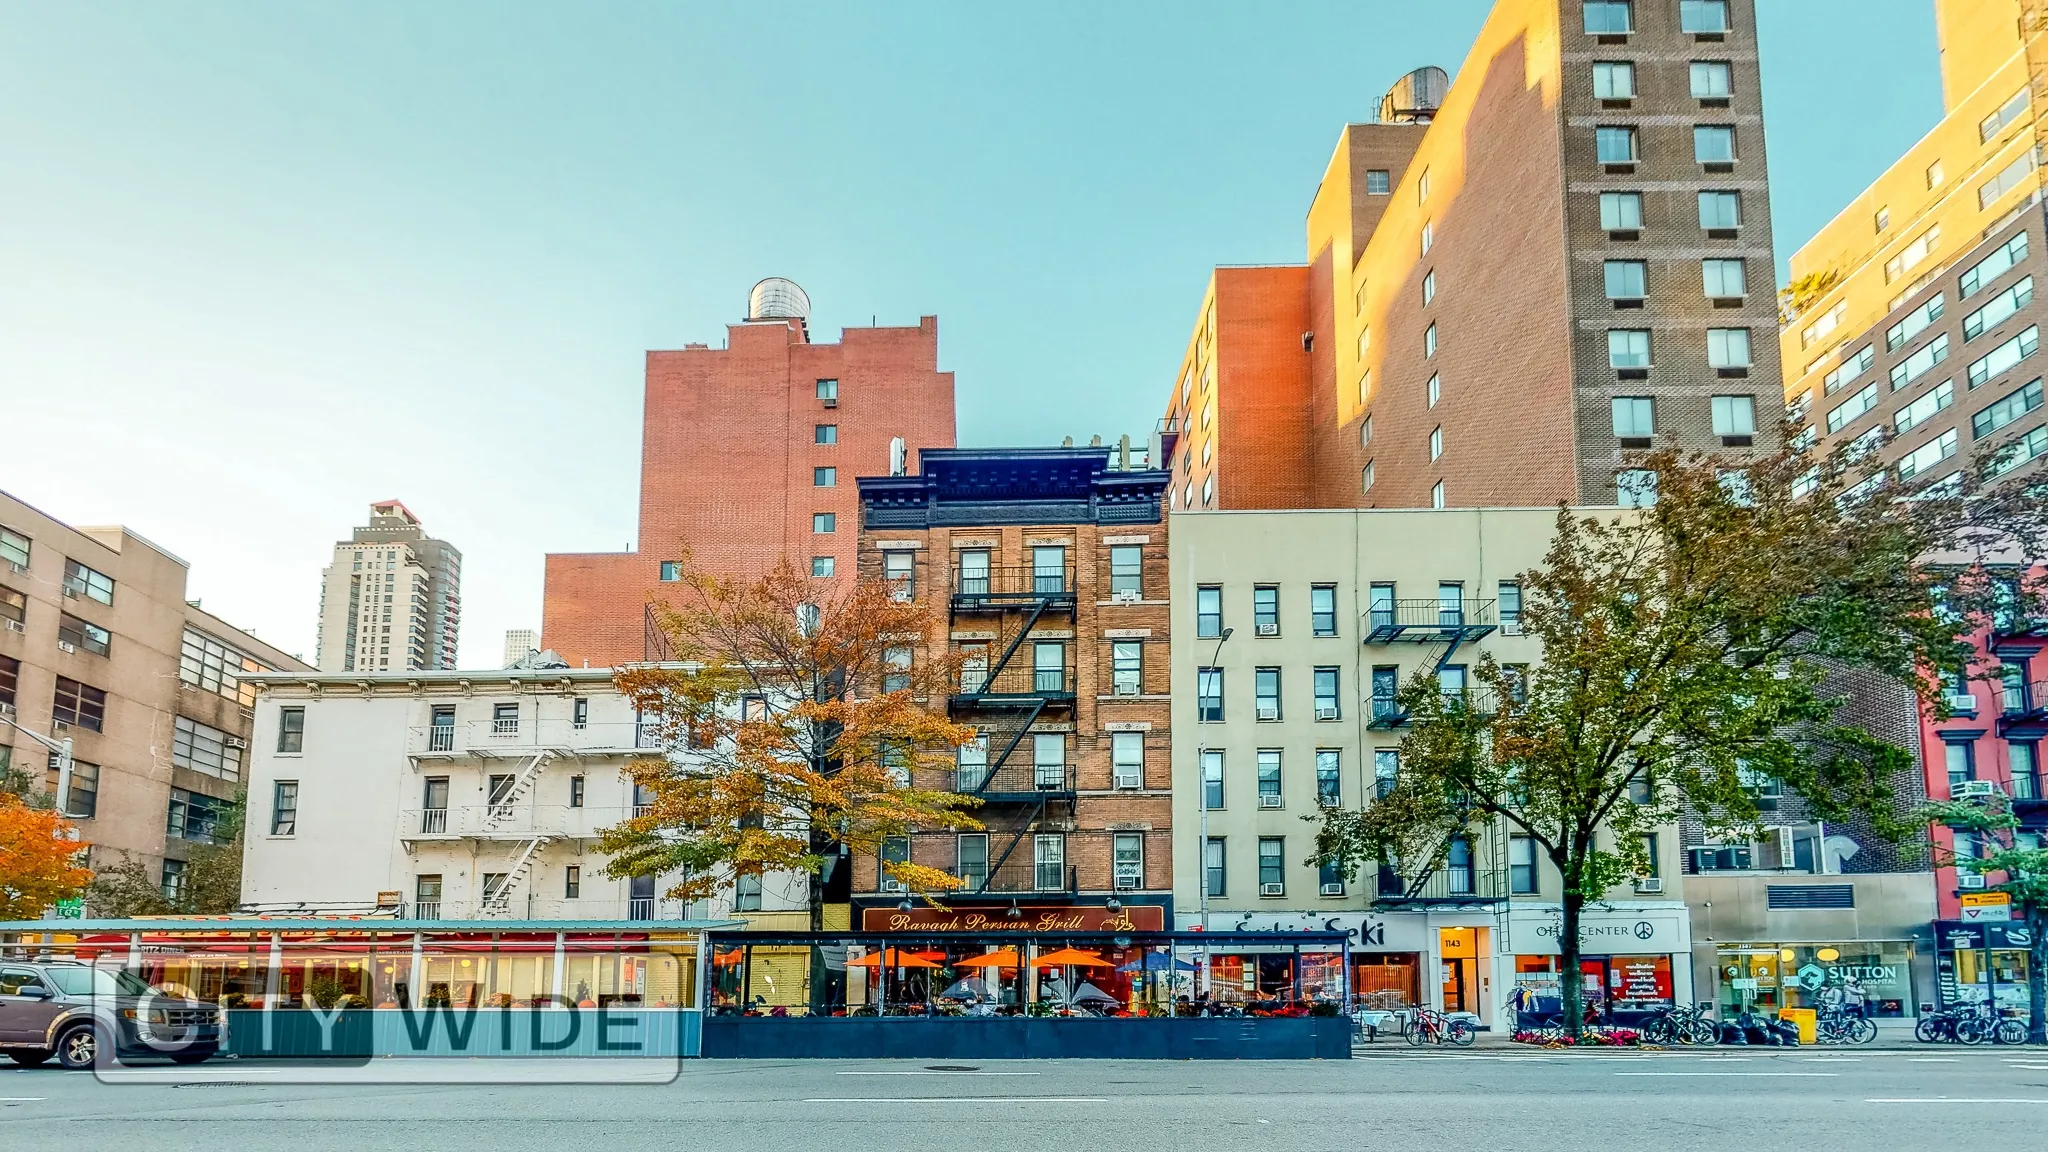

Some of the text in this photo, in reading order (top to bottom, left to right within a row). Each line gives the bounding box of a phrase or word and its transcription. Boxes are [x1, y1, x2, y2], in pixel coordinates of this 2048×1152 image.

[889, 912, 1083, 931] Ravagh Persian Grill
[1579, 925, 1628, 936] CENTER
[1445, 940, 1461, 948] 1143
[1828, 966, 1897, 979] SUTTON
